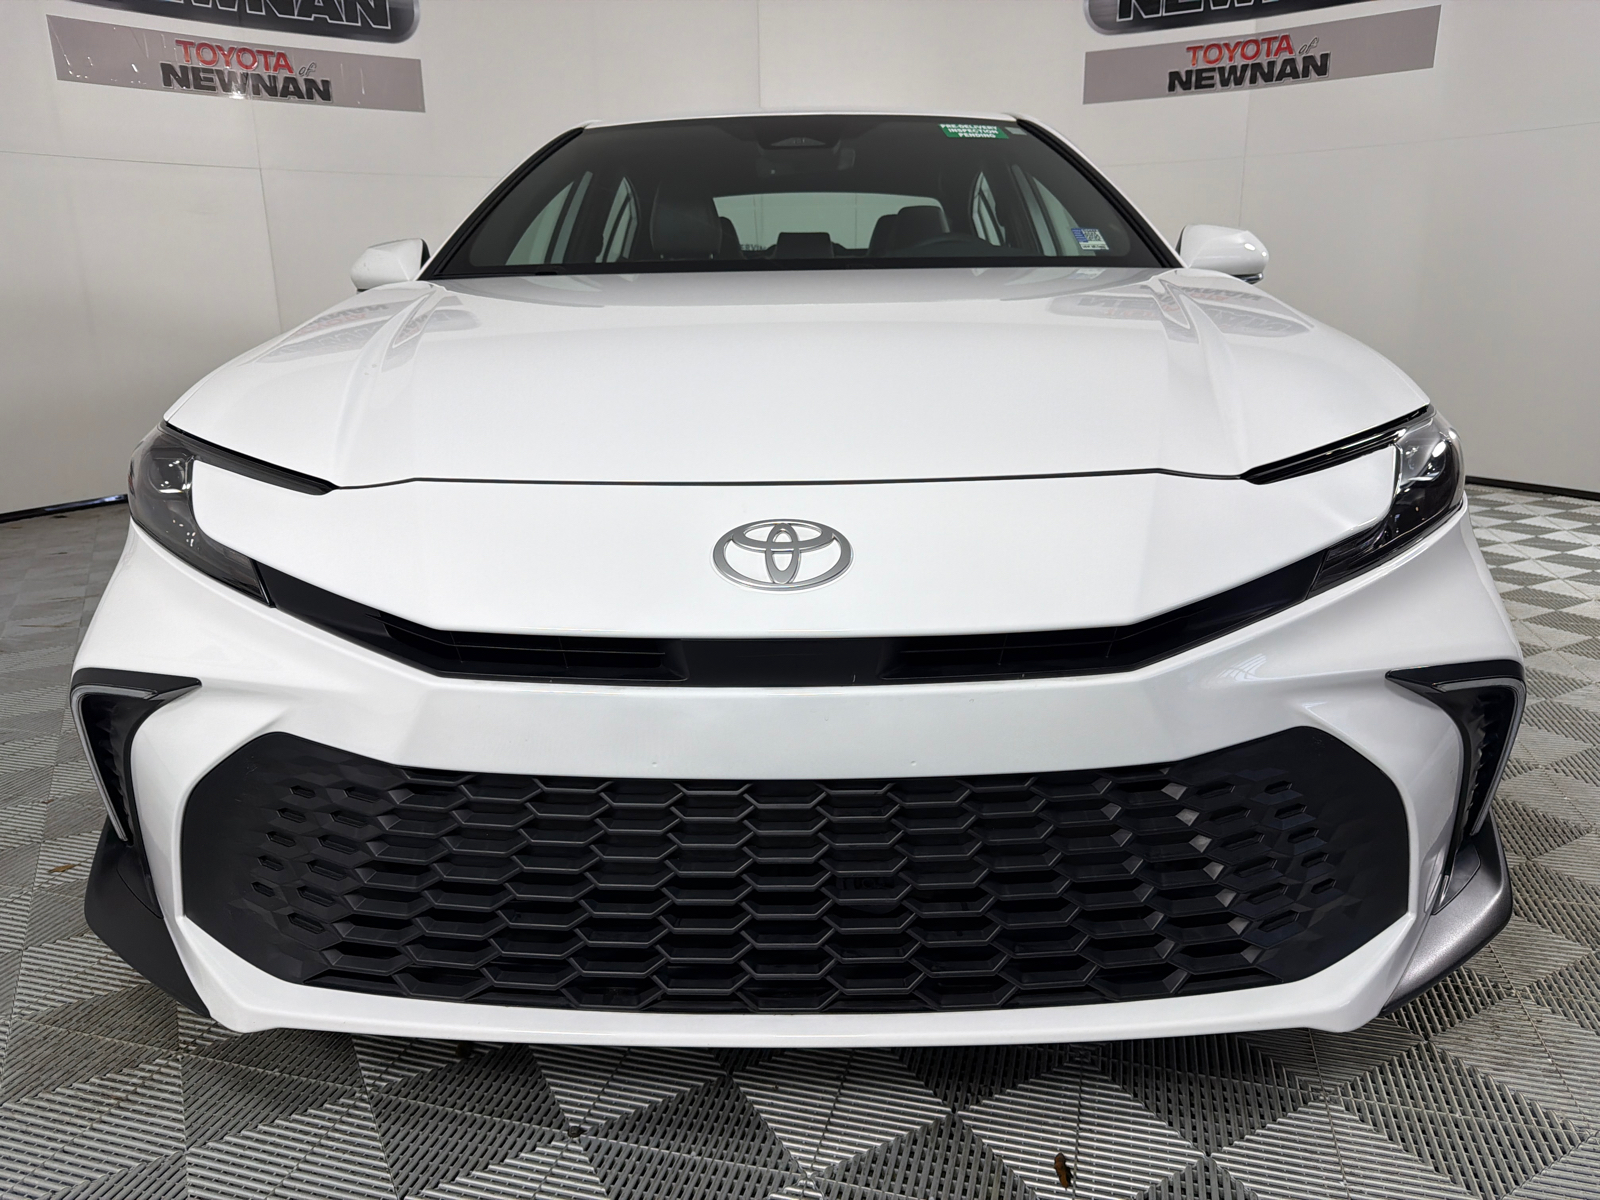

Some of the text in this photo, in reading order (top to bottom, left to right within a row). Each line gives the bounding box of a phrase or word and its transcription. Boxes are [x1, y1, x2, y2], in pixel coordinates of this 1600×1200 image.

[175, 39, 317, 77] TOYOTA of
[1186, 34, 1320, 67] TOYOTA of
[160, 62, 332, 101] NEWNAN
[1168, 53, 1331, 93] NEWNAN
